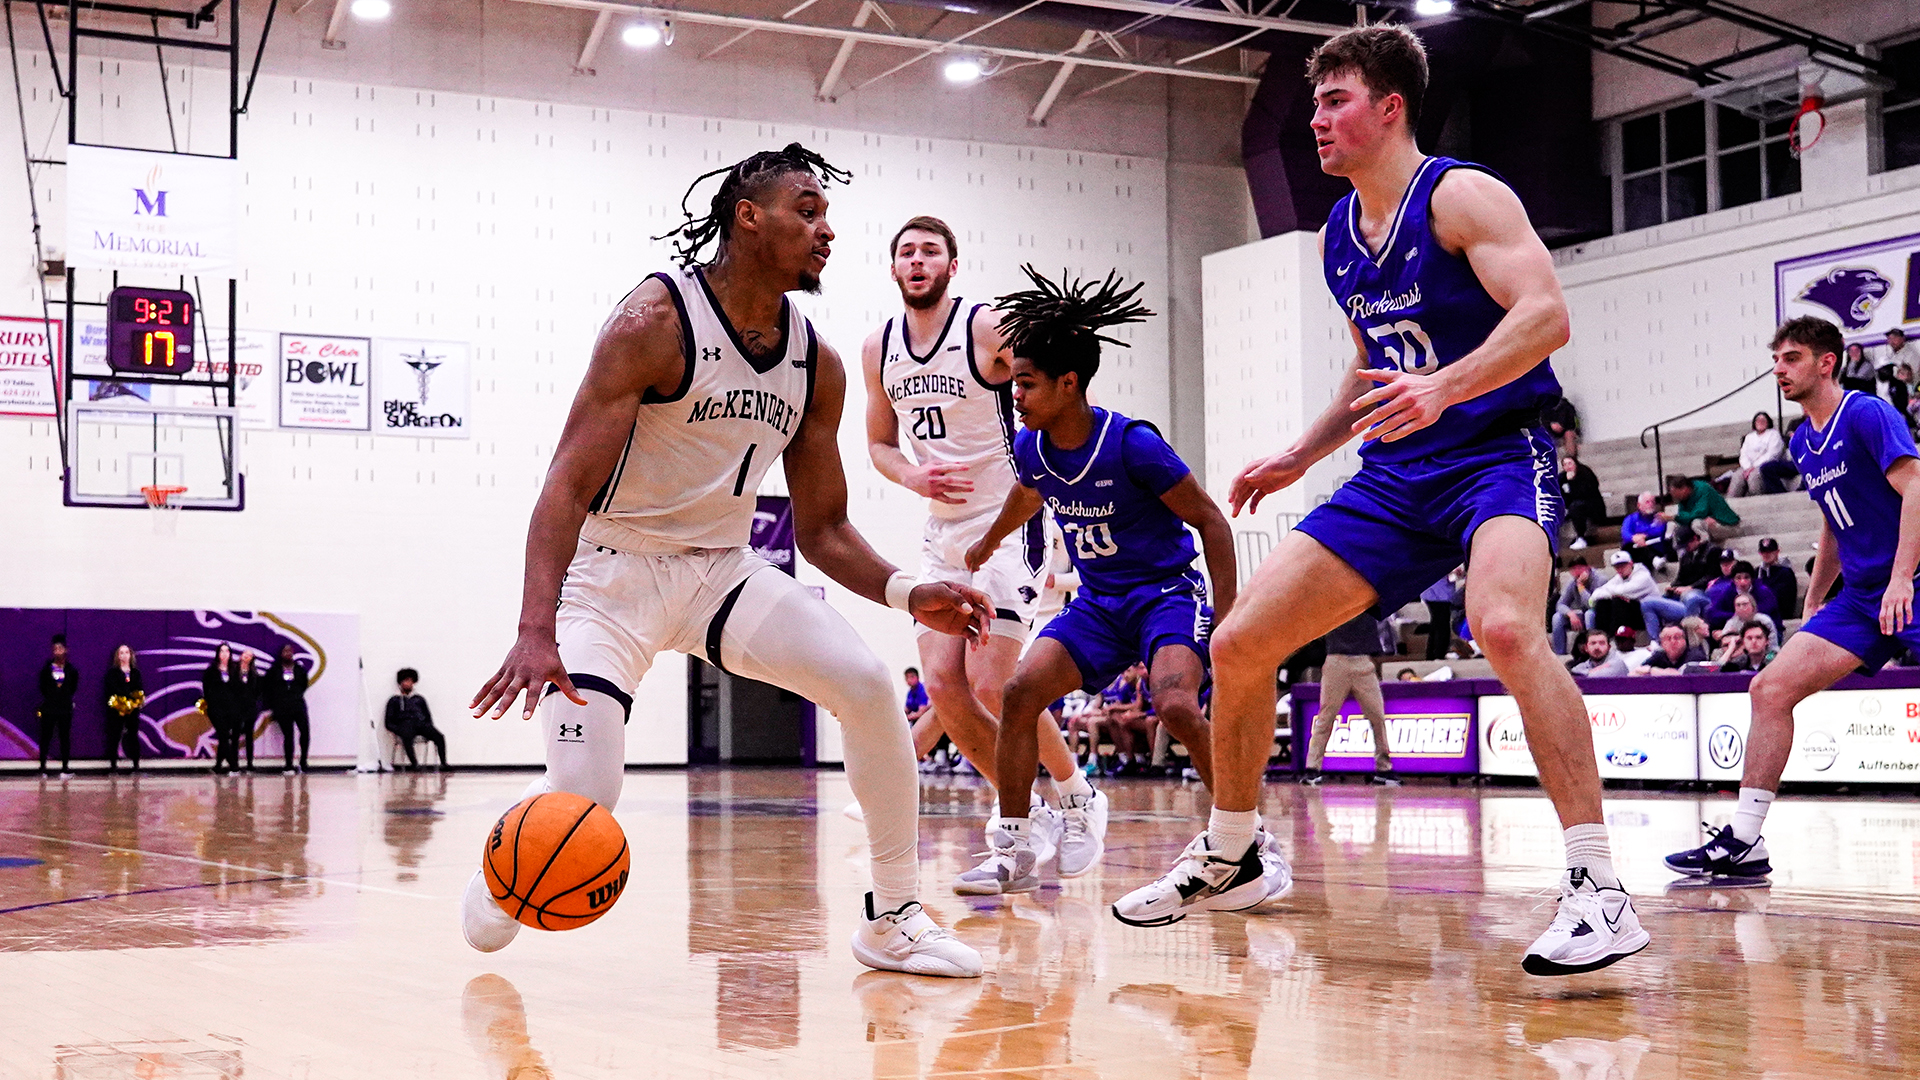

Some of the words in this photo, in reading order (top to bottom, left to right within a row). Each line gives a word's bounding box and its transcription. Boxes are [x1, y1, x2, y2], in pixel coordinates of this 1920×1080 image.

[132, 188, 170, 217] M
[137, 223, 166, 233] THE
[93, 231, 208, 257] MEMORIAL
[134, 298, 190, 325] 9:21
[1347, 282, 1422, 321] Rockhurst
[144, 331, 175, 367] 17
[319, 343, 359, 357] Clair
[1367, 319, 1440, 376] 50
[286, 358, 365, 386] BOWL
[888, 374, 967, 402] McKENDREE
[384, 399, 419, 413] BIKE
[387, 412, 462, 428] SURGEON
[911, 405, 947, 441] 20
[733, 443, 758, 497] 1
[1805, 461, 1848, 490] Rockhurst
[1049, 496, 1116, 518] Rockhurst
[1824, 486, 1855, 530] 11
[1063, 522, 1119, 559] 20
[1592, 711, 1619, 727] KIA
[1846, 723, 1895, 737] Allstate
[1643, 731, 1689, 740] HYUNDAI
[1611, 749, 1641, 766] Ford
